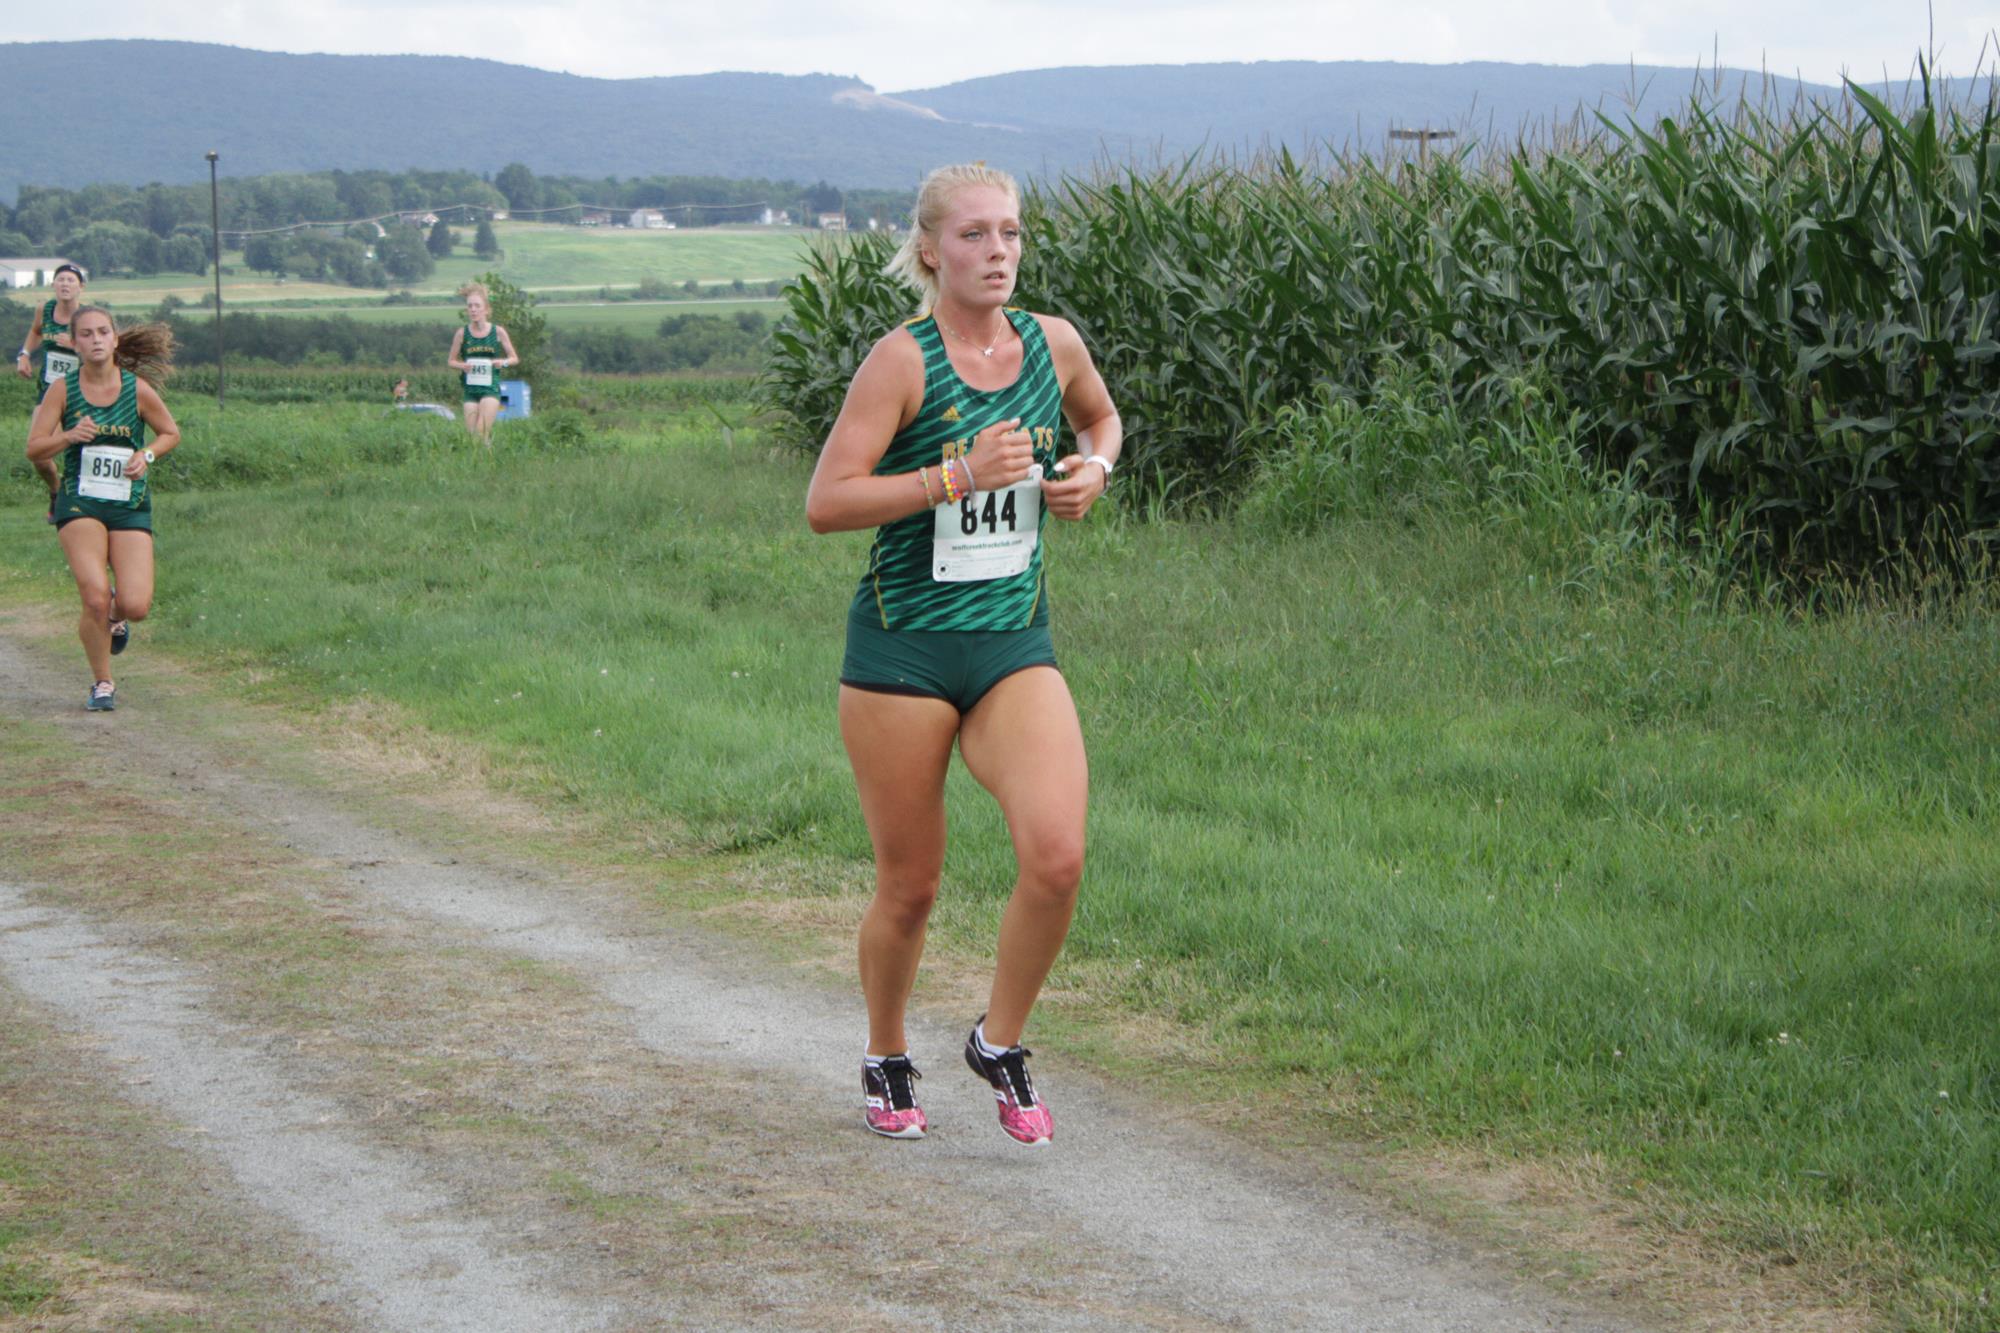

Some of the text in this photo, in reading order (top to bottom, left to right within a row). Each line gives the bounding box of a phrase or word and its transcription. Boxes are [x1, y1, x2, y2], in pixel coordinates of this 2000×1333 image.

[52, 360, 72, 374] 852
[471, 365, 487, 375] 845
[92, 457, 122, 479] 850
[960, 491, 1016, 535] 844
